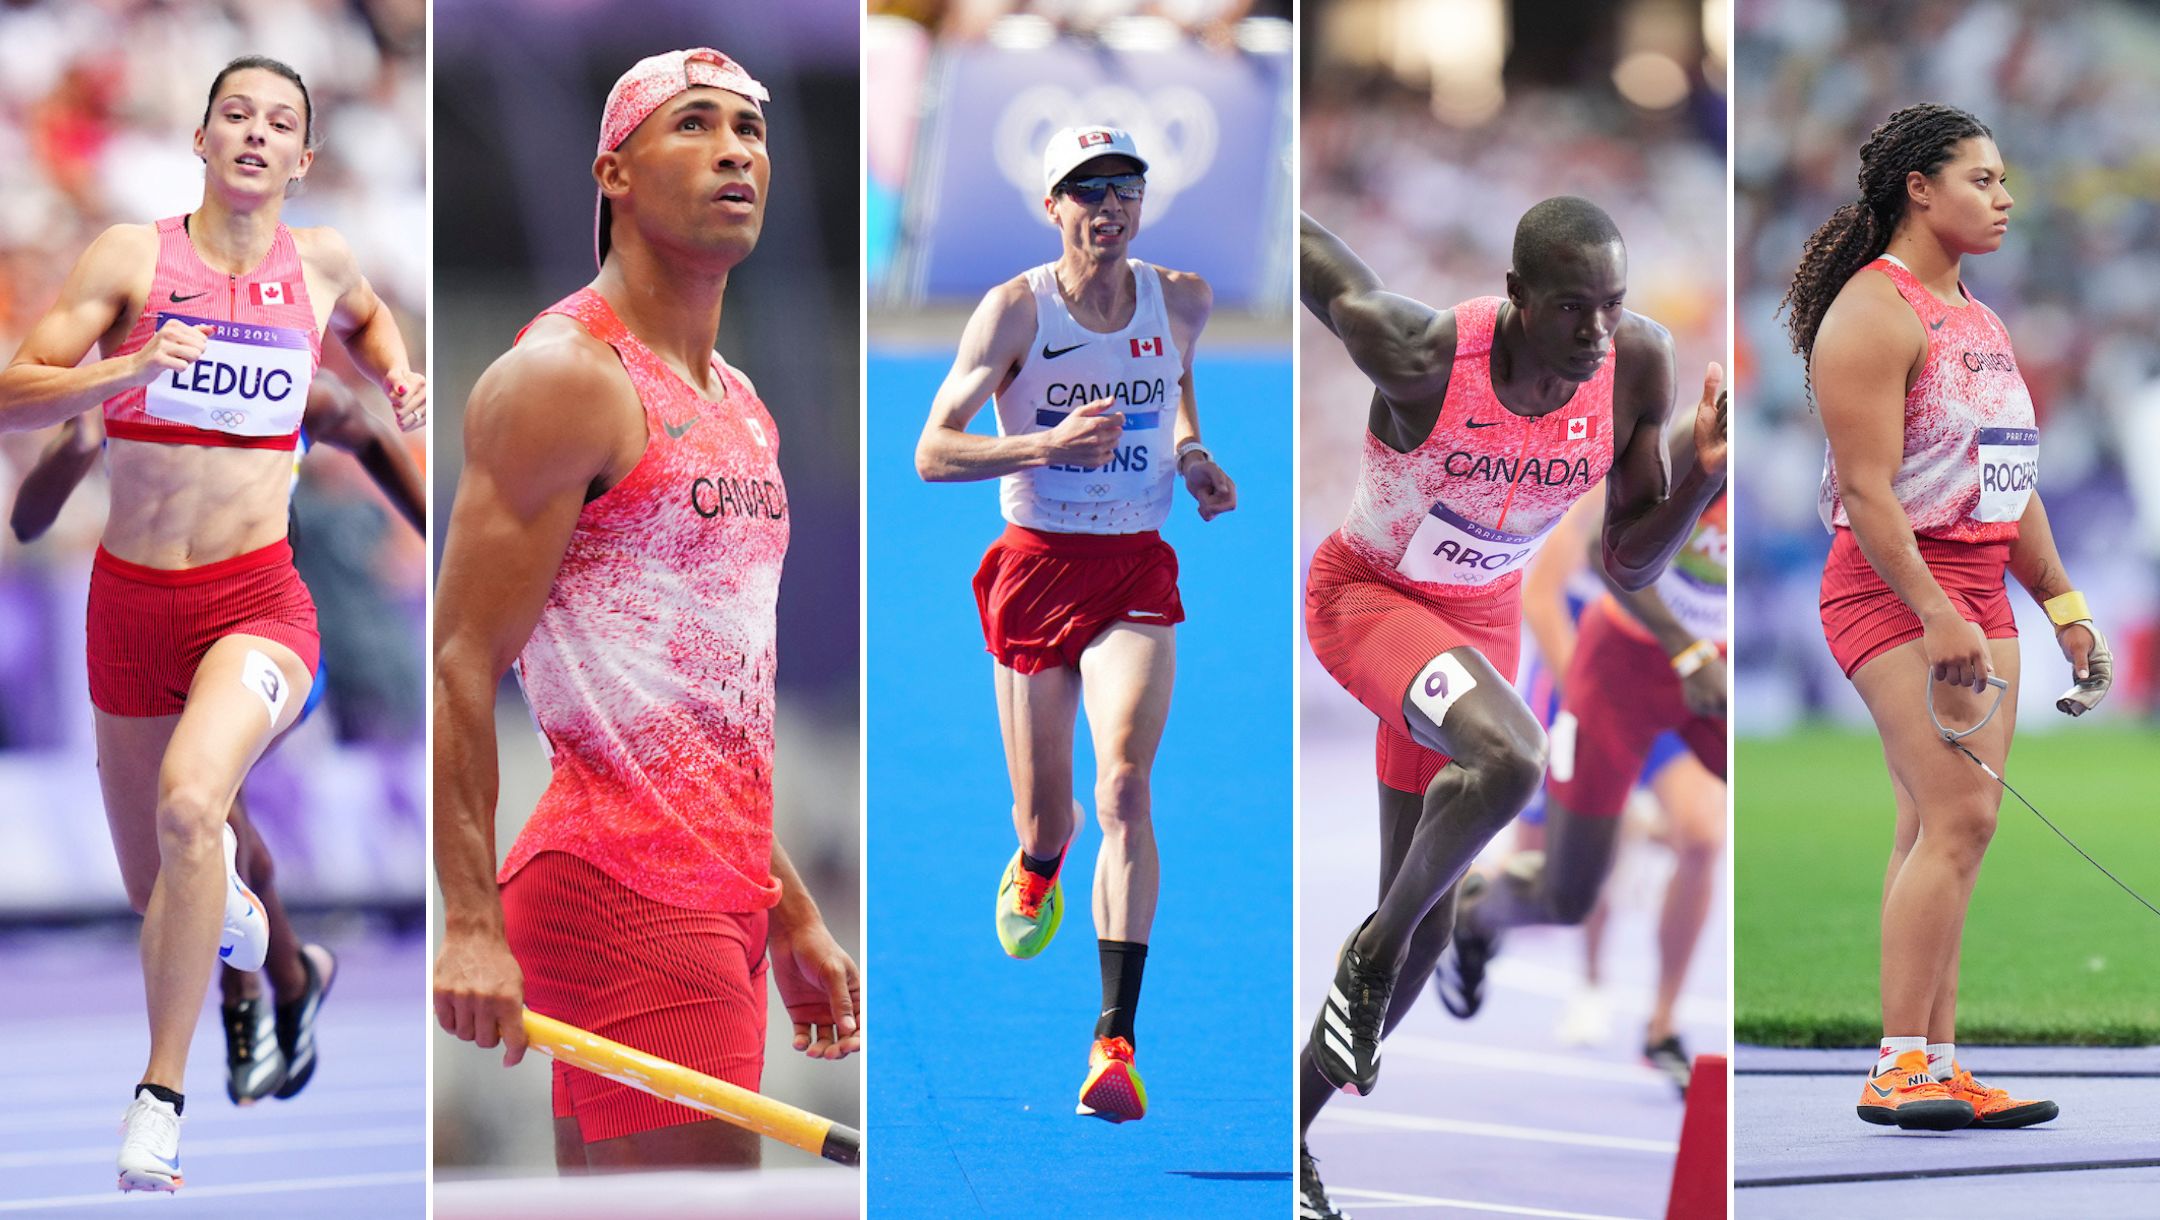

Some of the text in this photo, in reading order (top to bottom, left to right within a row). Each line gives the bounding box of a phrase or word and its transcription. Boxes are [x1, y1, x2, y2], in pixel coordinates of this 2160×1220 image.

[217, 326, 278, 342] RIS 2024
[1963, 352, 2012, 372] CANAD
[171, 360, 293, 402] LEDUC
[1046, 378, 1165, 407] CANADA
[1444, 451, 1590, 487] CANADA
[691, 477, 786, 520] CANAD
[1466, 523, 1503, 541] PARIS
[1432, 540, 1531, 570] AROP
[260, 669, 279, 703] 3
[1424, 670, 1449, 699] 9
[1908, 1074, 1929, 1087] NI
